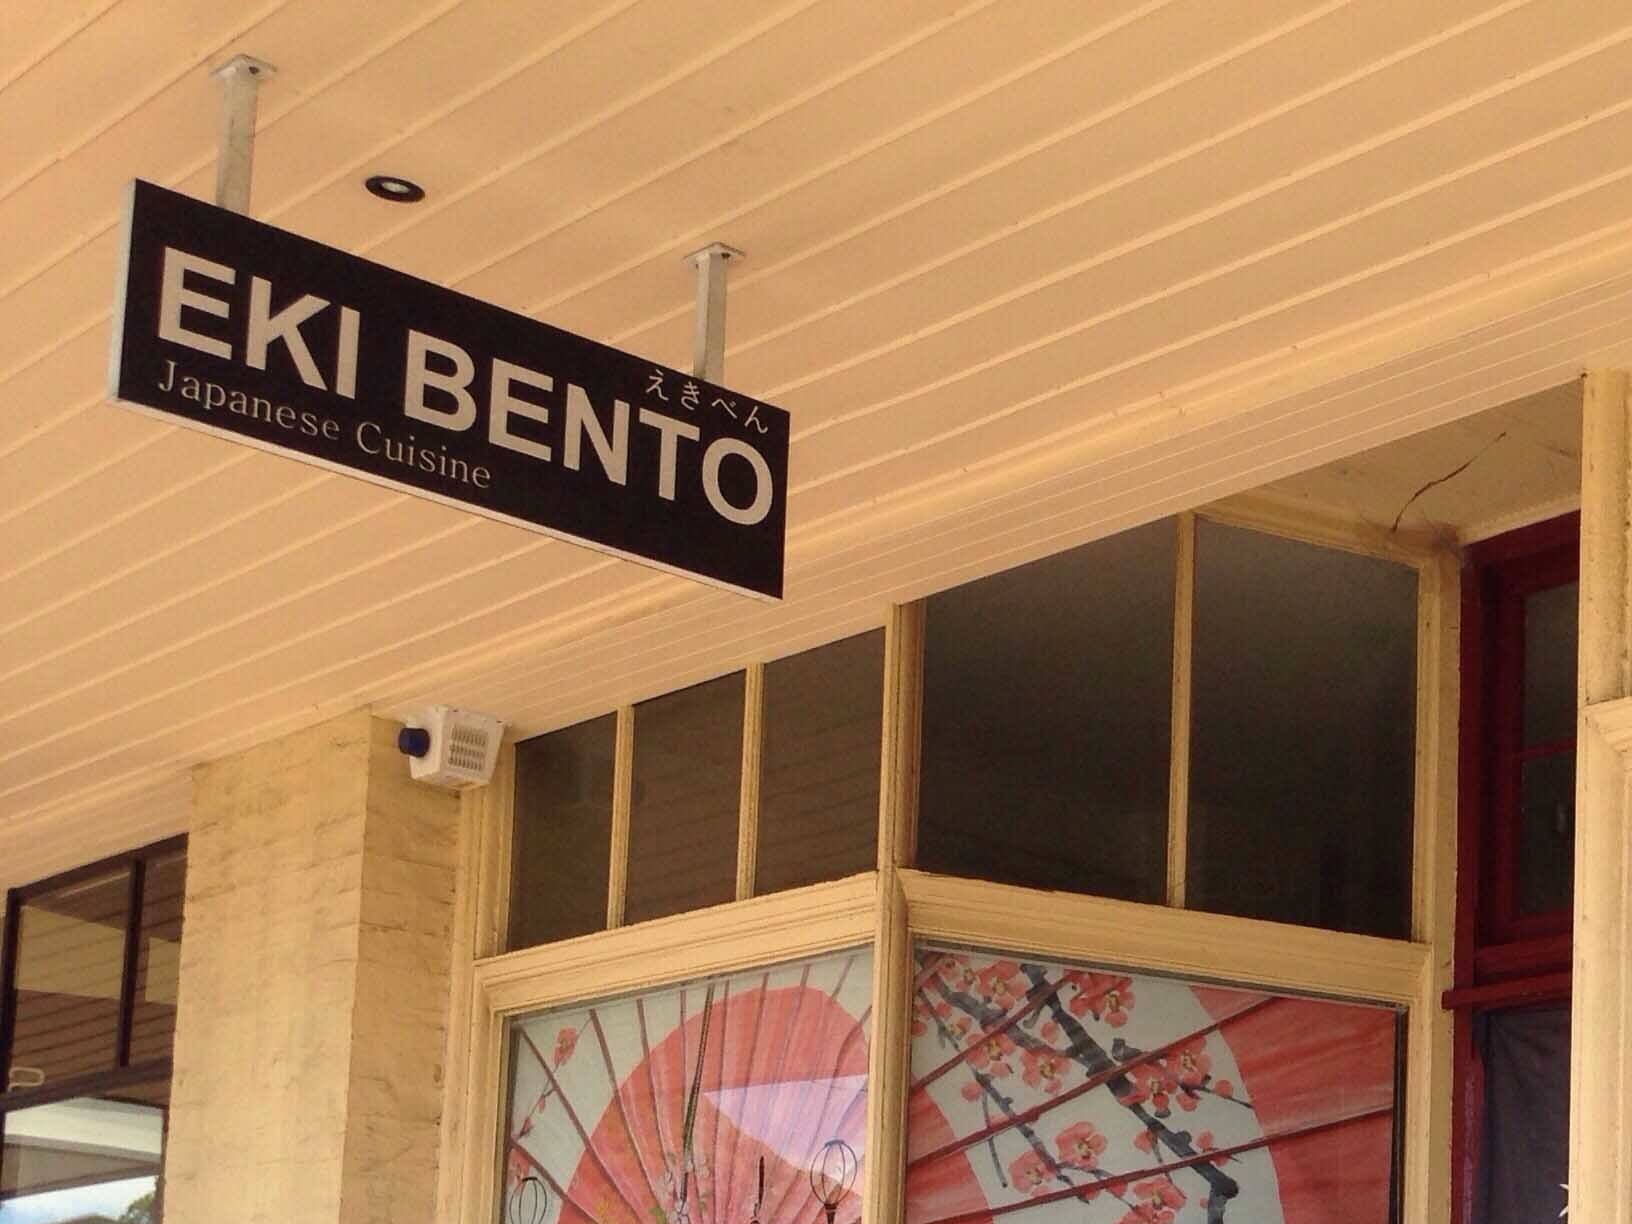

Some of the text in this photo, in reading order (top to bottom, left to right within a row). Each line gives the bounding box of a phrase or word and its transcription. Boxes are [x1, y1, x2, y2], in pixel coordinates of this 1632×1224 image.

[157, 246, 774, 526] EKI BENTO
[158, 359, 491, 490] Japanese Cuisine
[646, 369, 769, 433] えきべん
